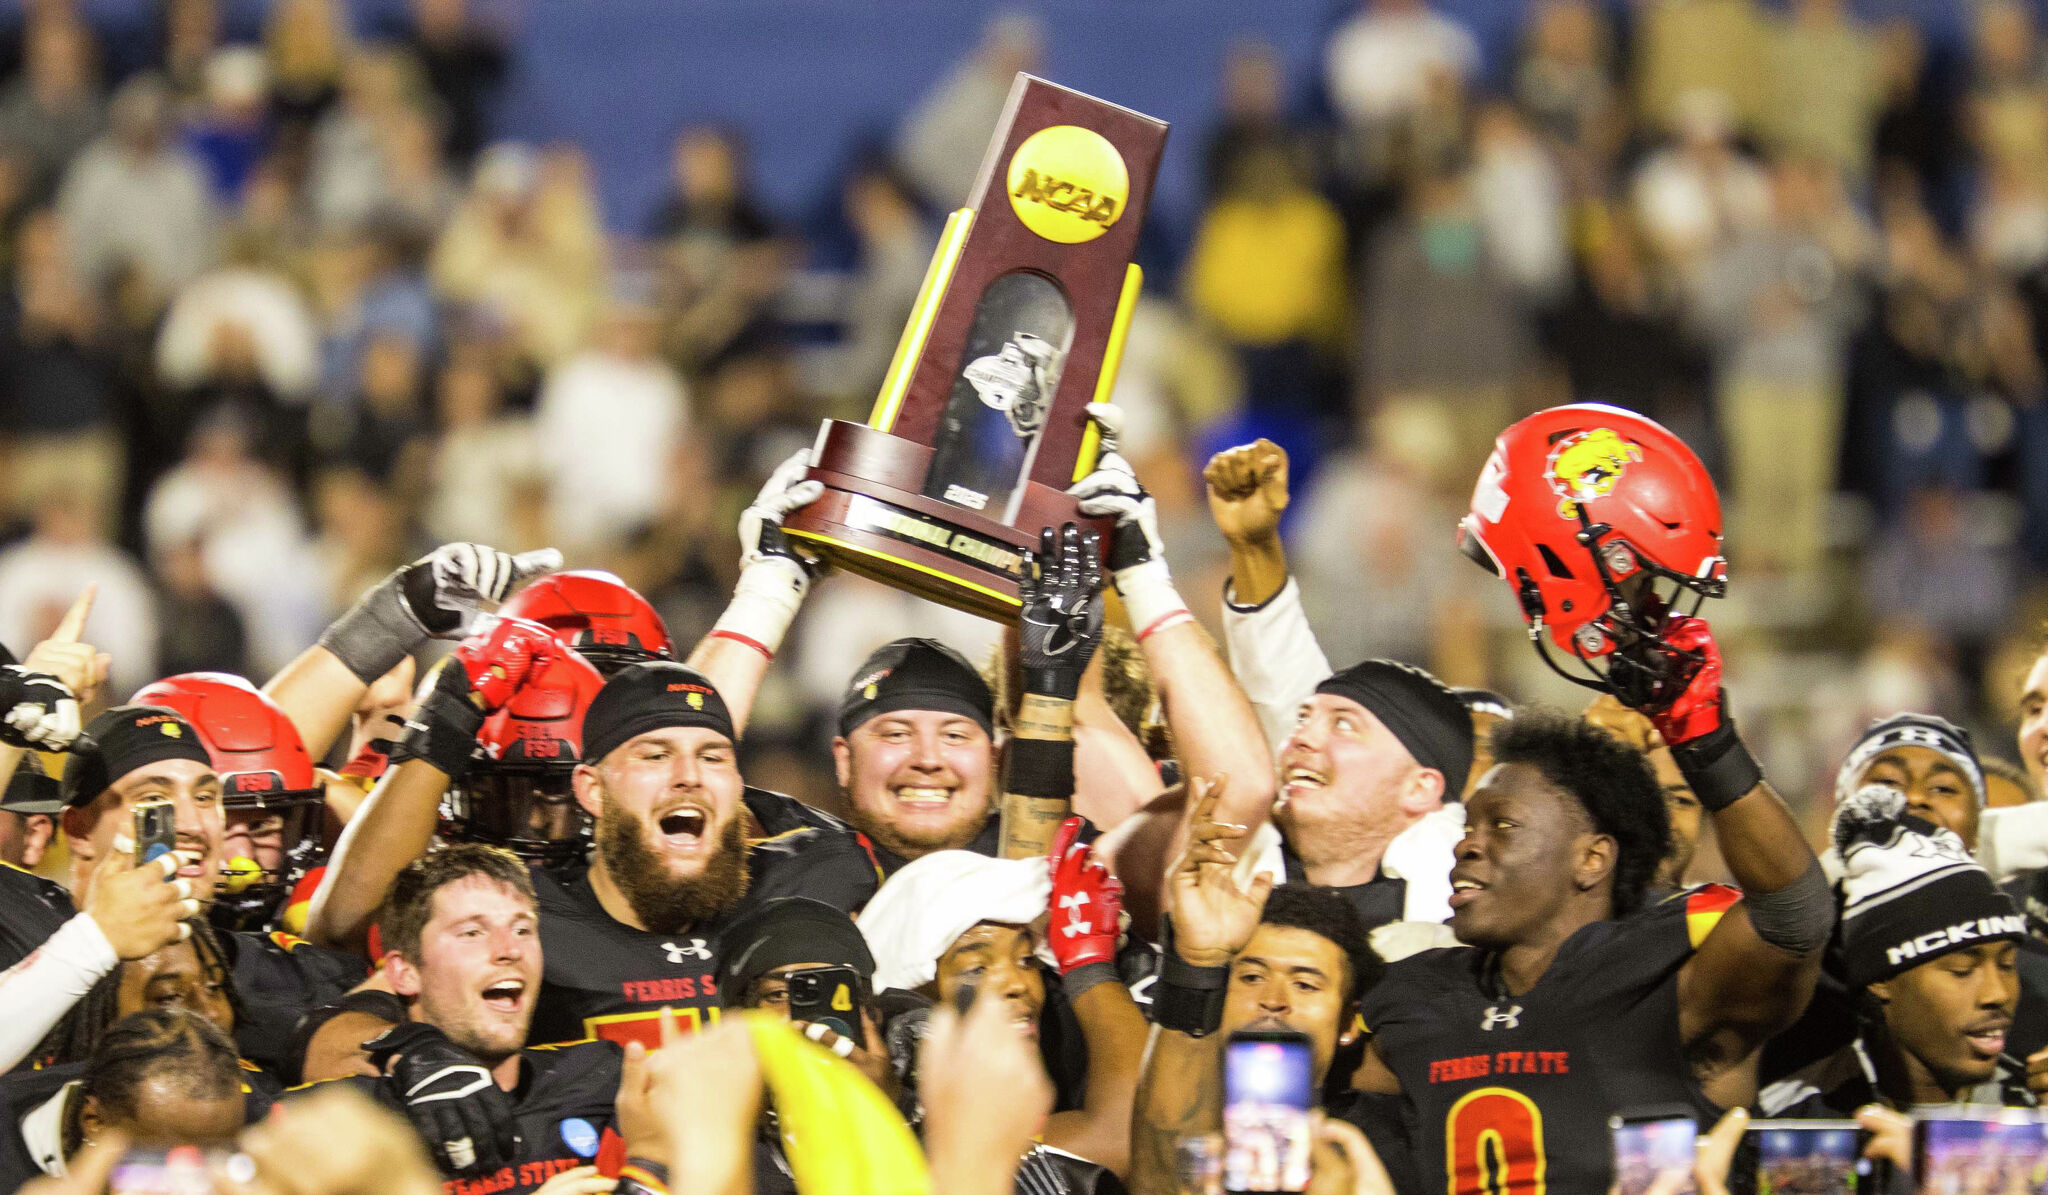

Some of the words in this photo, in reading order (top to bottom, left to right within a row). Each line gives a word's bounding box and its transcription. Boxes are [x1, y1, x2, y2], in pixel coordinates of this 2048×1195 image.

[1014, 168, 1117, 229] NCAA
[943, 484, 990, 510] 2025
[523, 740, 560, 758] FSU
[236, 774, 273, 792] FSU
[622, 977, 697, 1002] FERRIS
[1428, 1054, 1491, 1084] FERRIS
[1495, 1051, 1570, 1074] STATE
